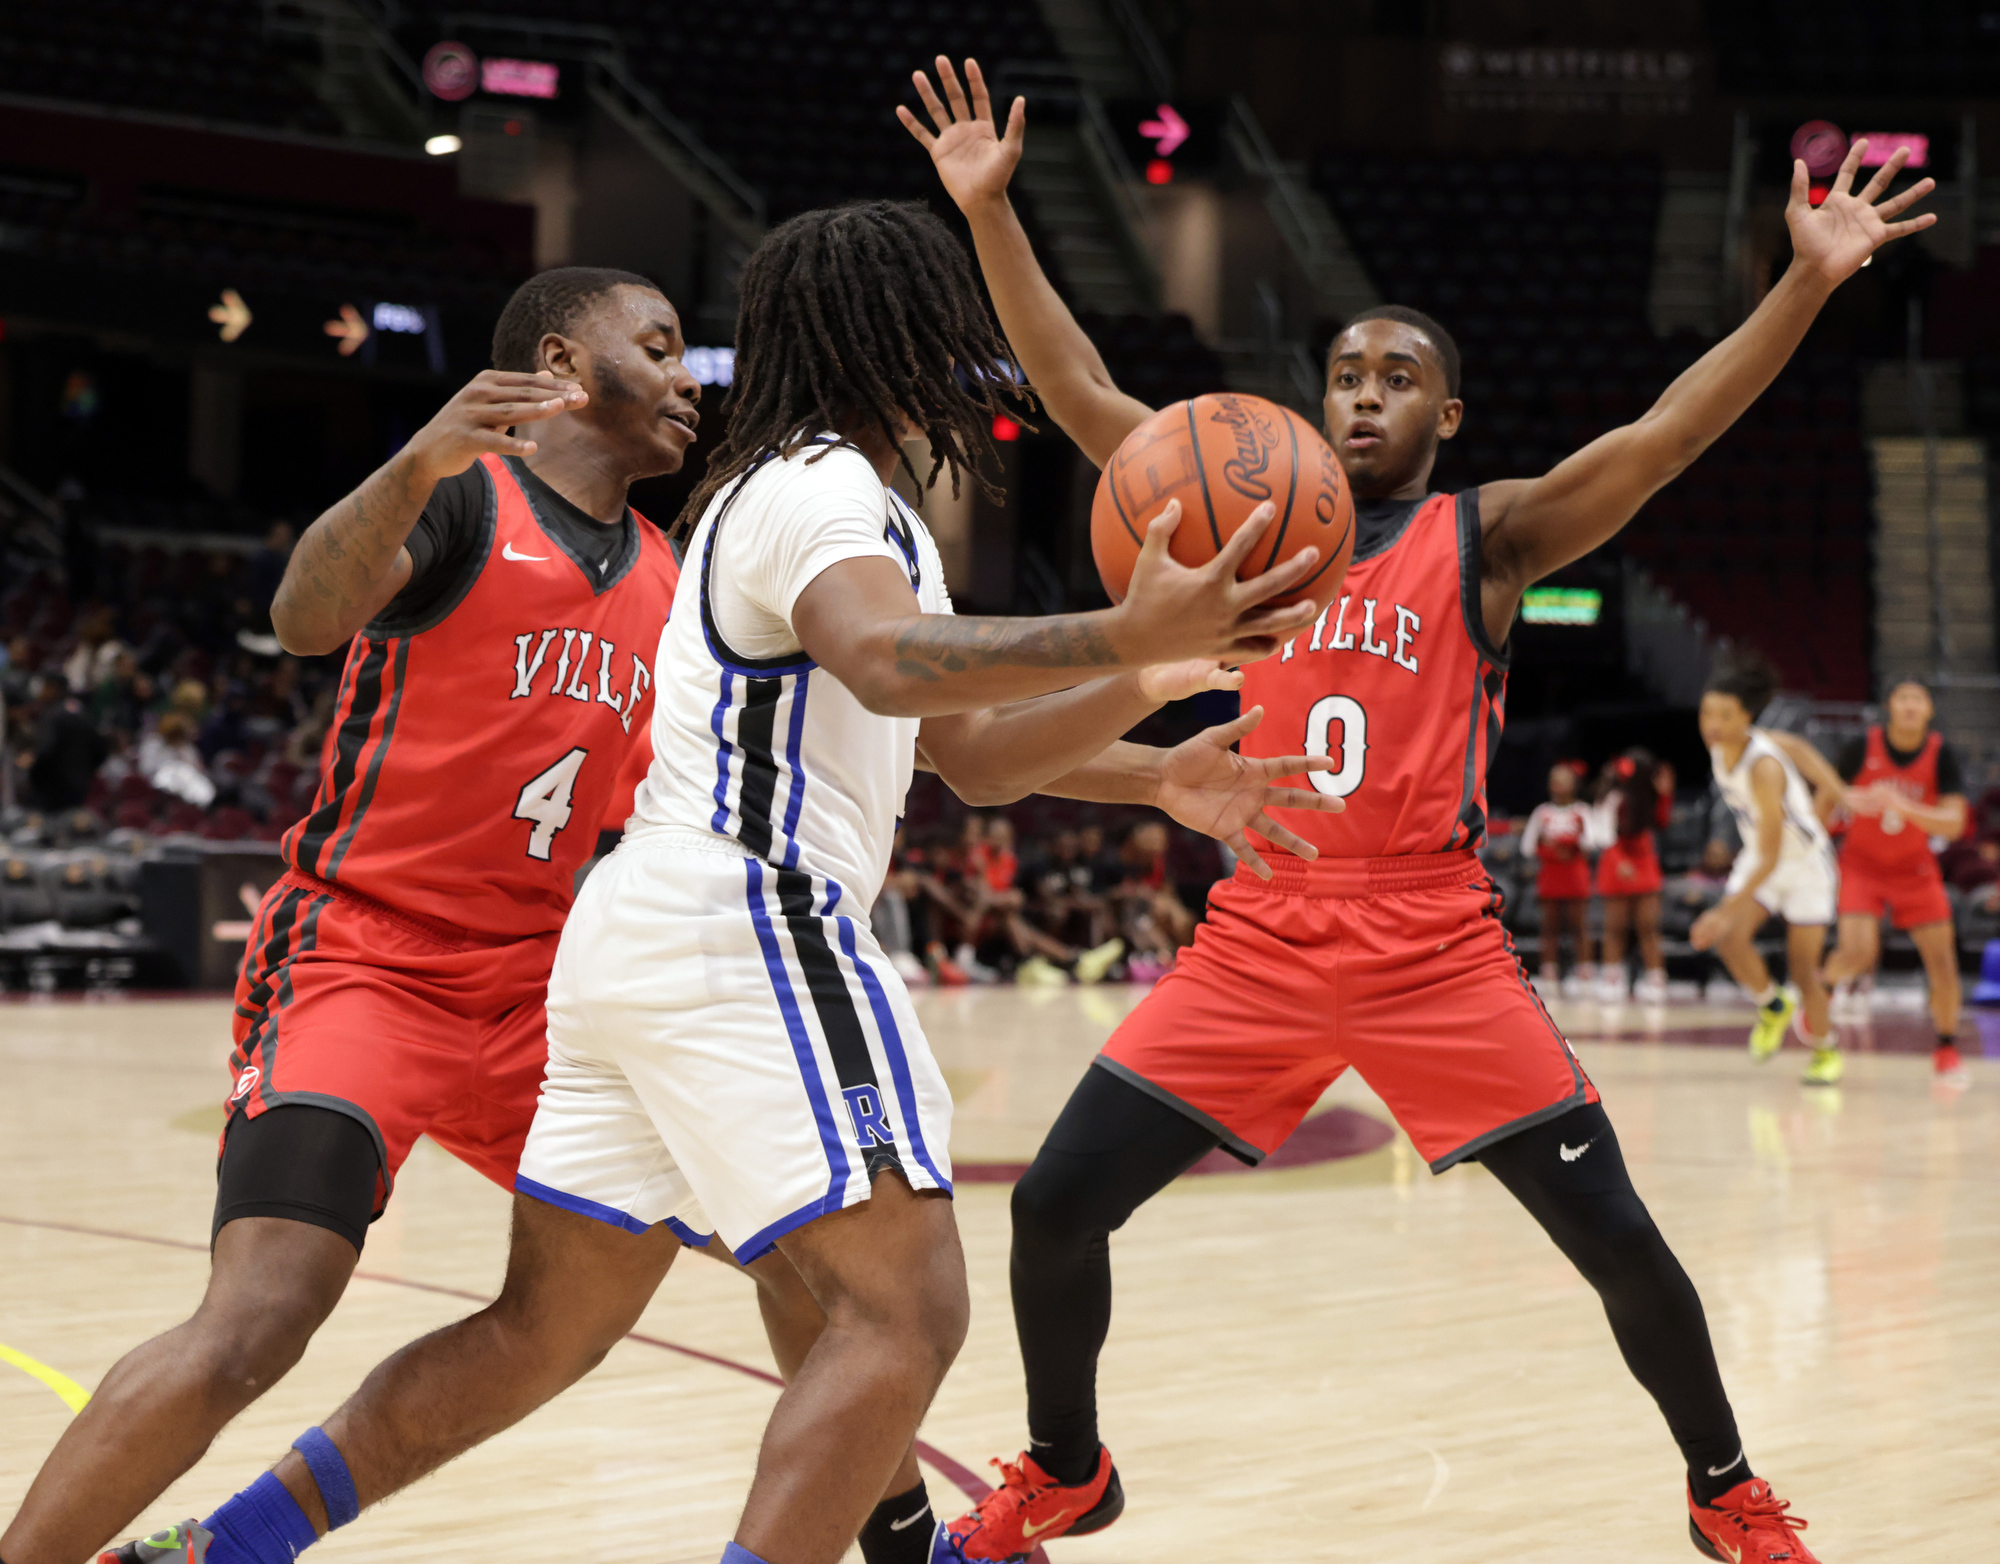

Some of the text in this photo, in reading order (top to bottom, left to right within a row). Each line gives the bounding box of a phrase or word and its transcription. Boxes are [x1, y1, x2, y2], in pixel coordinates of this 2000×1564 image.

[509, 627, 651, 736] VILLE
[1302, 694, 1370, 798] 0
[510, 745, 589, 862] 4
[841, 1083, 894, 1149] R
